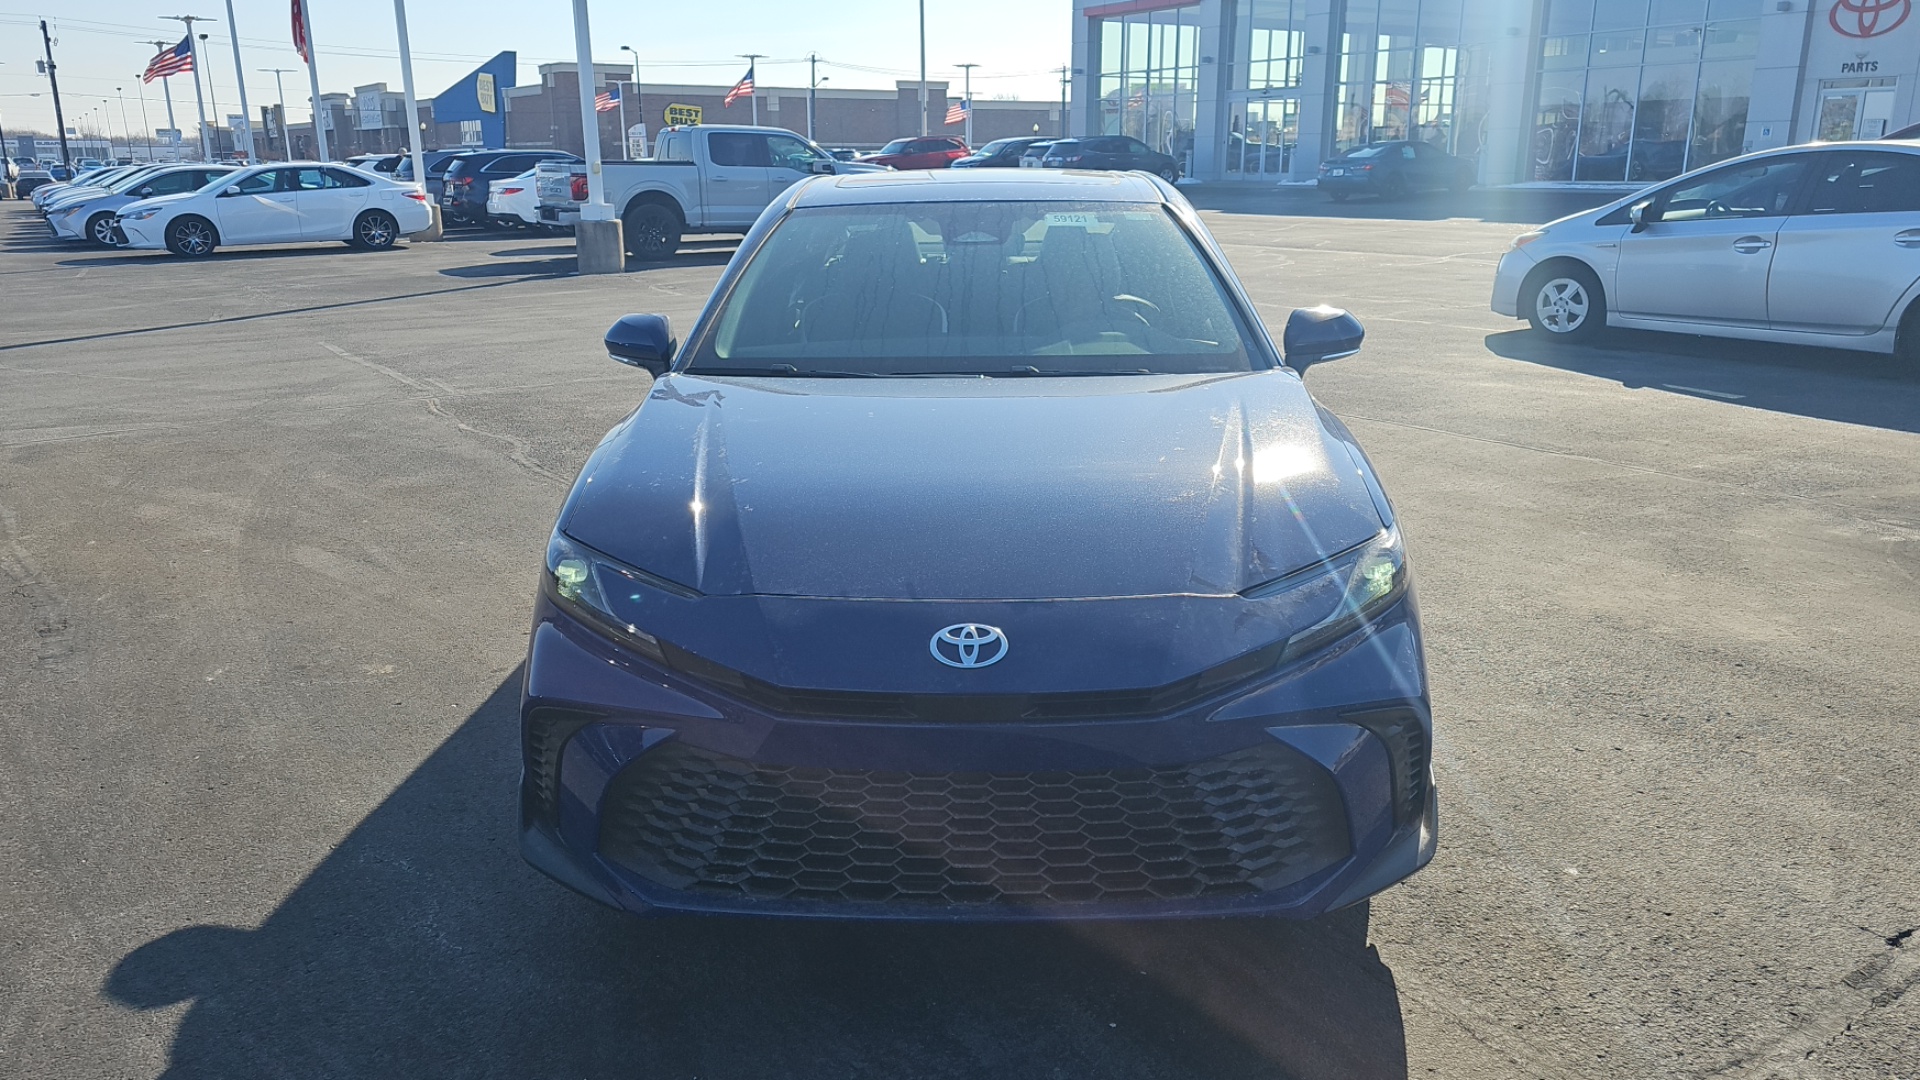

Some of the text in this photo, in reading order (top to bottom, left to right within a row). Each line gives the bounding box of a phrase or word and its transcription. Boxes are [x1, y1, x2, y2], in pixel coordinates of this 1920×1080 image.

[1841, 61, 1878, 73] PARTS
[478, 79, 493, 92] BEST
[669, 107, 700, 118] BEST
[1053, 214, 1087, 223] 59121
